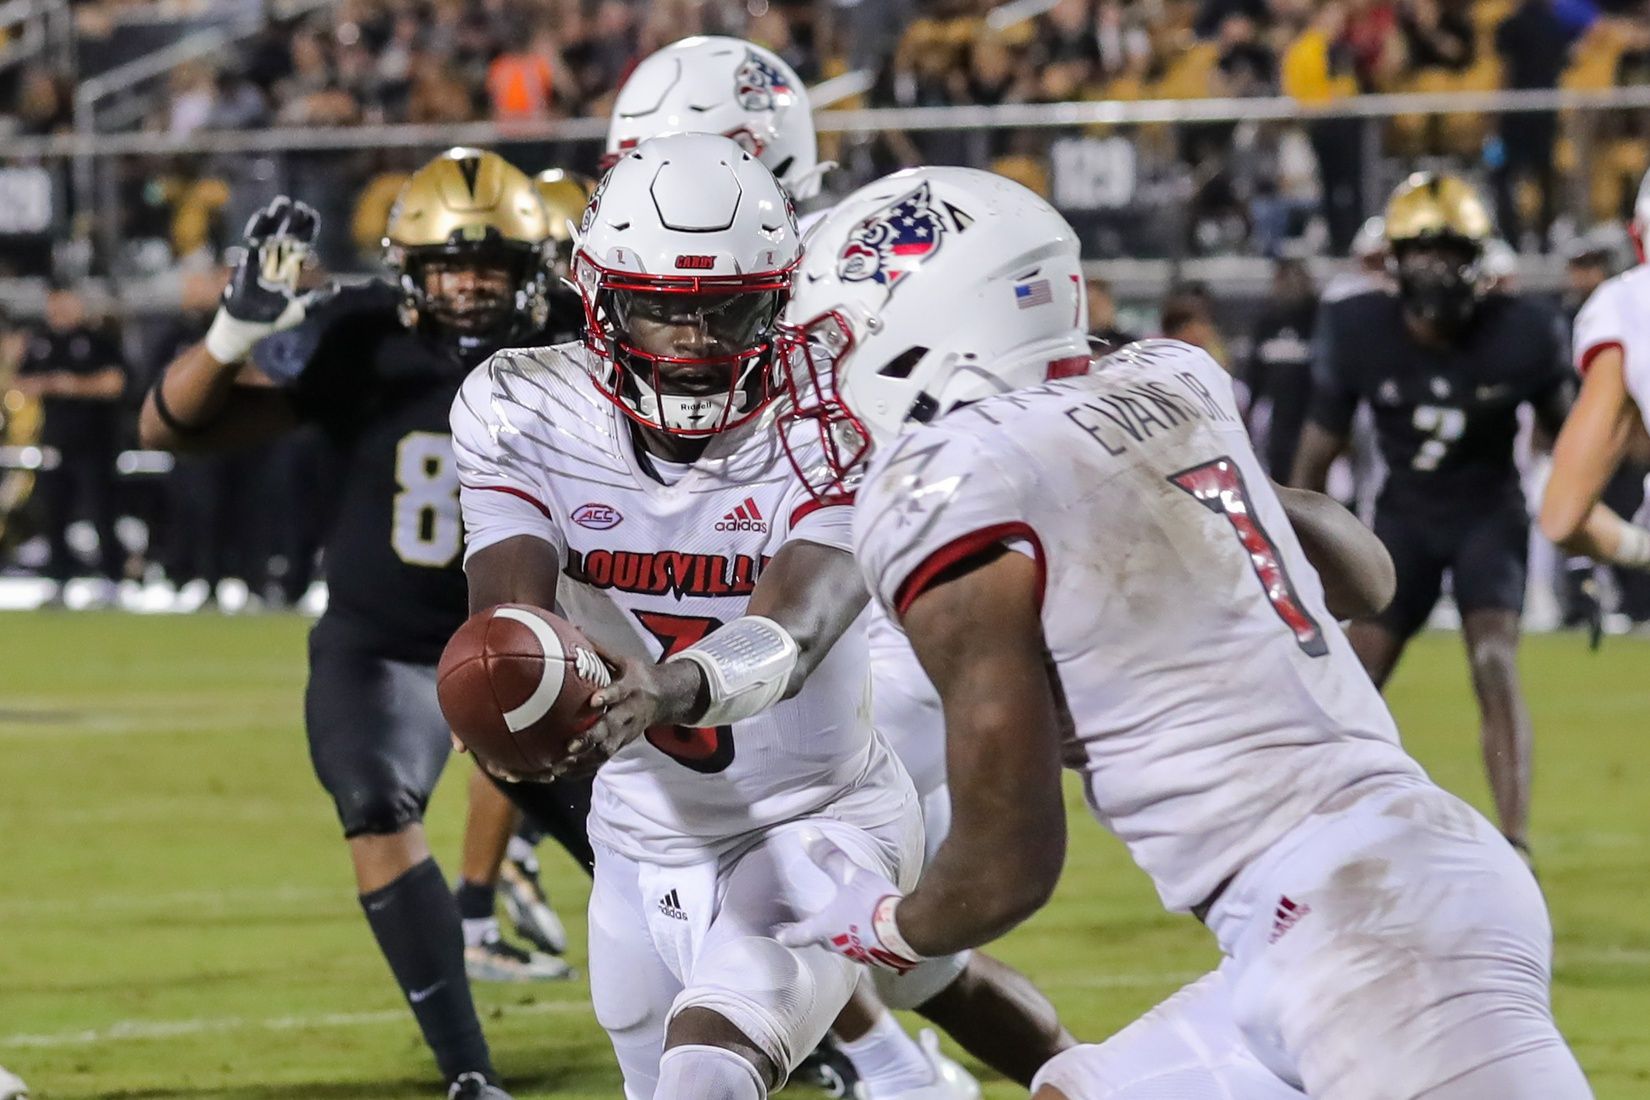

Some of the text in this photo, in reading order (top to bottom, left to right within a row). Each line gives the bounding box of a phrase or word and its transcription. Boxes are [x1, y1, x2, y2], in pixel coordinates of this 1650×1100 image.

[680, 400, 712, 411] Riddell
[1063, 371, 1236, 457] EVANS JR.
[391, 430, 462, 568] 8
[714, 516, 768, 534] adidas
